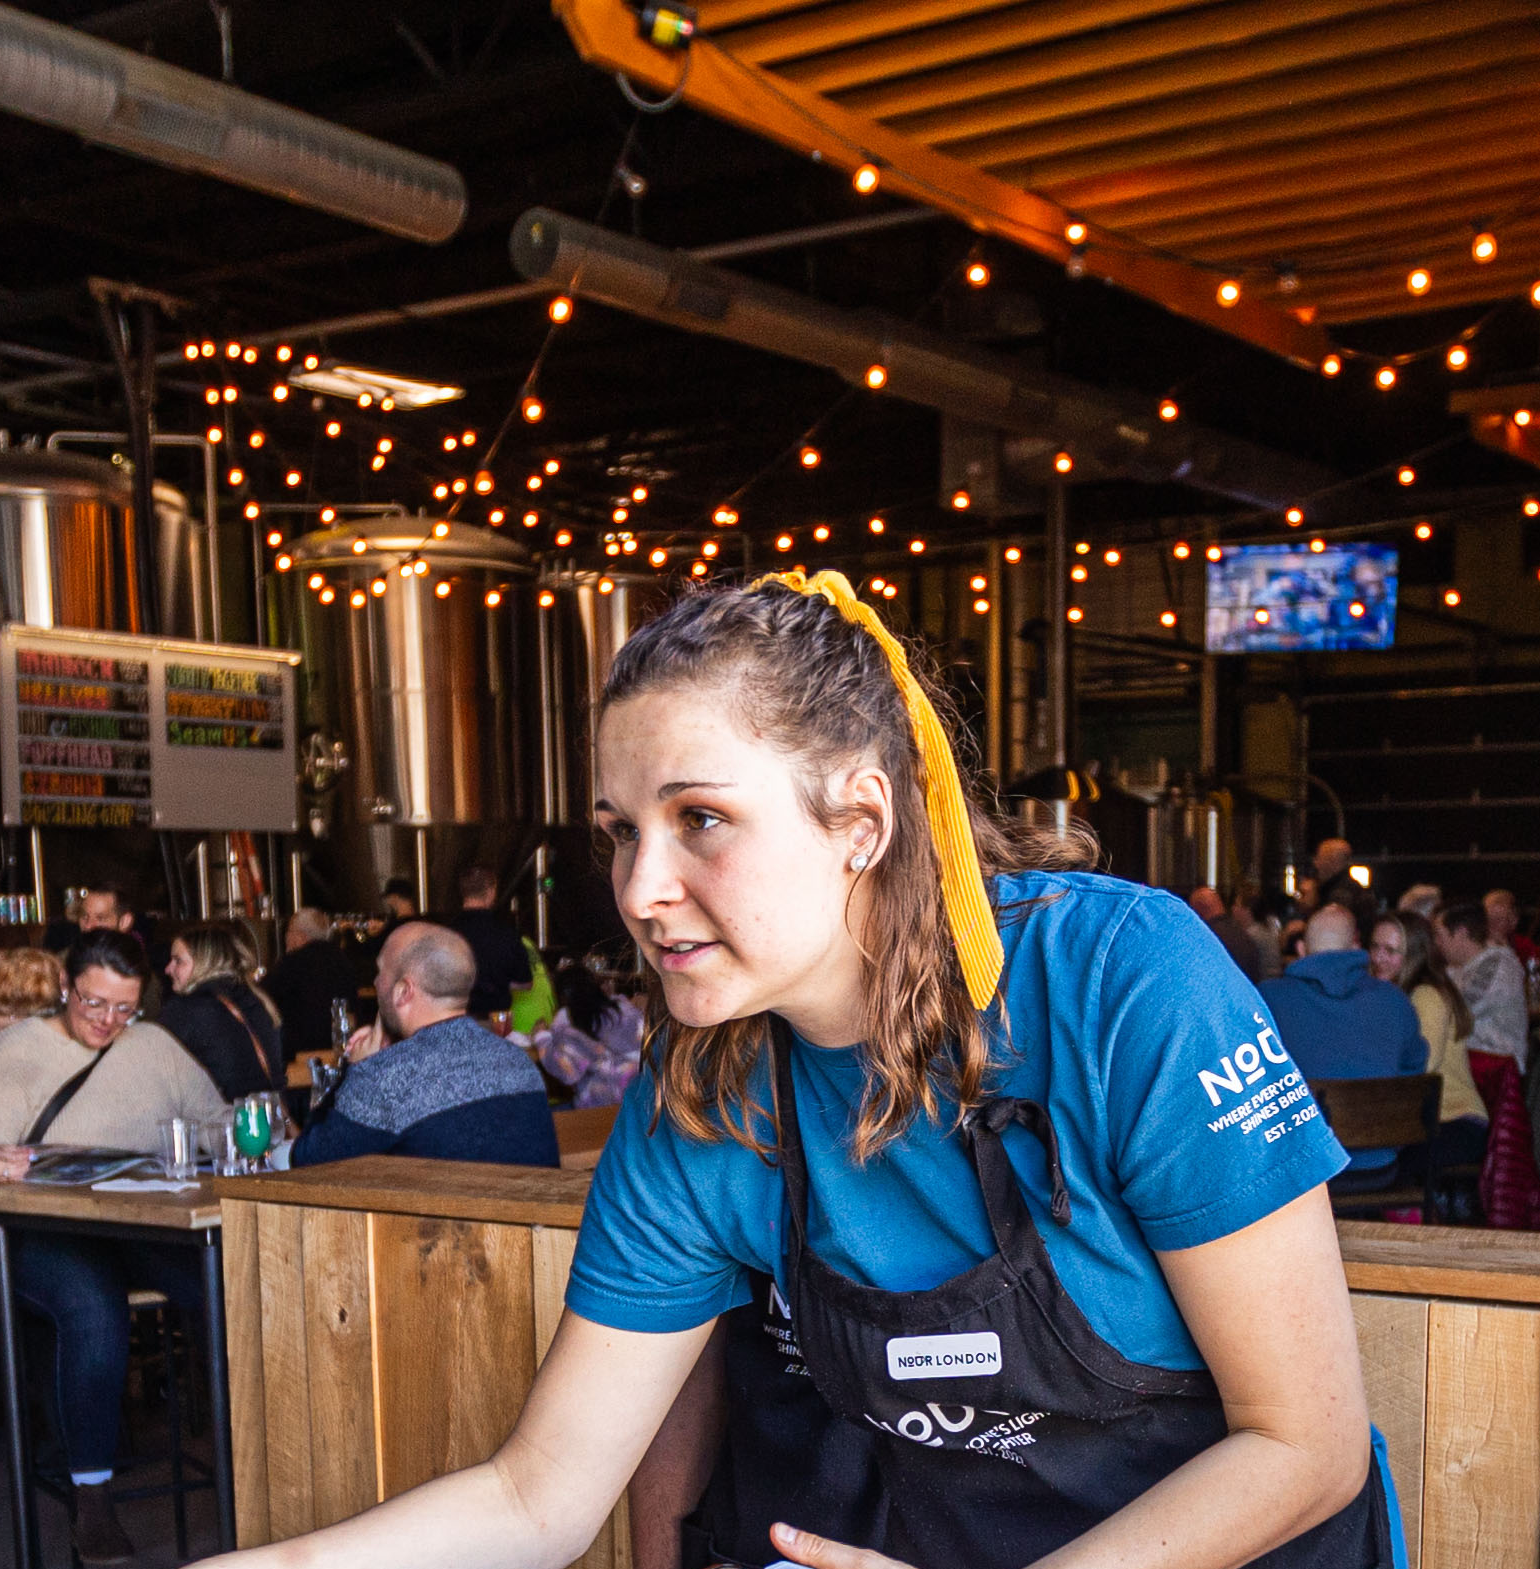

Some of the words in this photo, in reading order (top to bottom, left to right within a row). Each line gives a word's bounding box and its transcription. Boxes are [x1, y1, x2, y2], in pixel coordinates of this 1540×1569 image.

[1207, 1102, 1254, 1133] WHERE
[1251, 1068, 1303, 1109] EVERYON
[1240, 1102, 1280, 1134] SHINES
[1278, 1085, 1310, 1109] BRIG
[1264, 1122, 1293, 1143] EST.
[777, 1342, 803, 1358] SHIN
[936, 1352, 997, 1366] LONDON
[1008, 1412, 1051, 1431] LIGH
